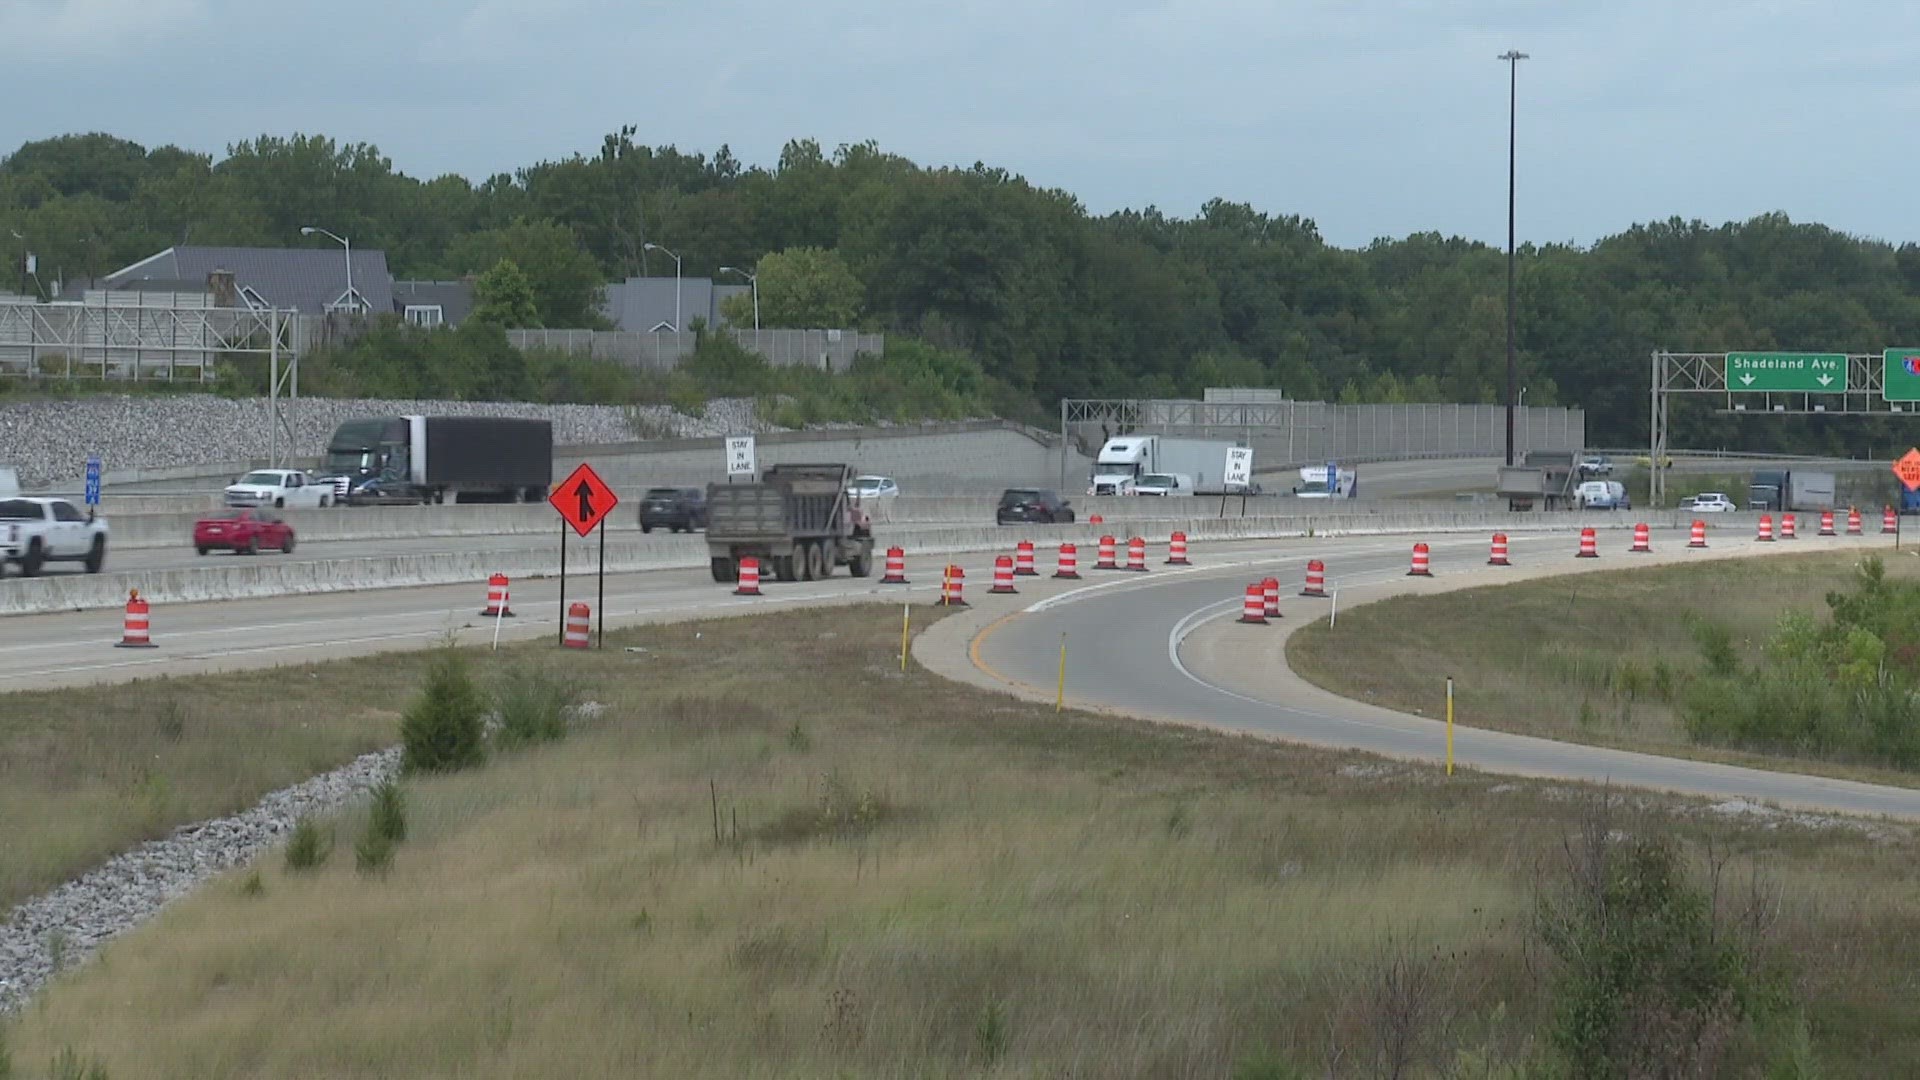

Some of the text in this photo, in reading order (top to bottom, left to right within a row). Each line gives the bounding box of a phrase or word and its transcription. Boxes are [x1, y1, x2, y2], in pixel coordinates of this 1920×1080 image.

[1734, 358, 1839, 370] Shadeland Ave.
[731, 441, 748, 449] STAY
[736, 452, 744, 460] IN
[1231, 451, 1246, 460] STAY
[731, 462, 752, 471] LANE
[1234, 462, 1241, 470] IN
[1227, 473, 1246, 482] LANE
